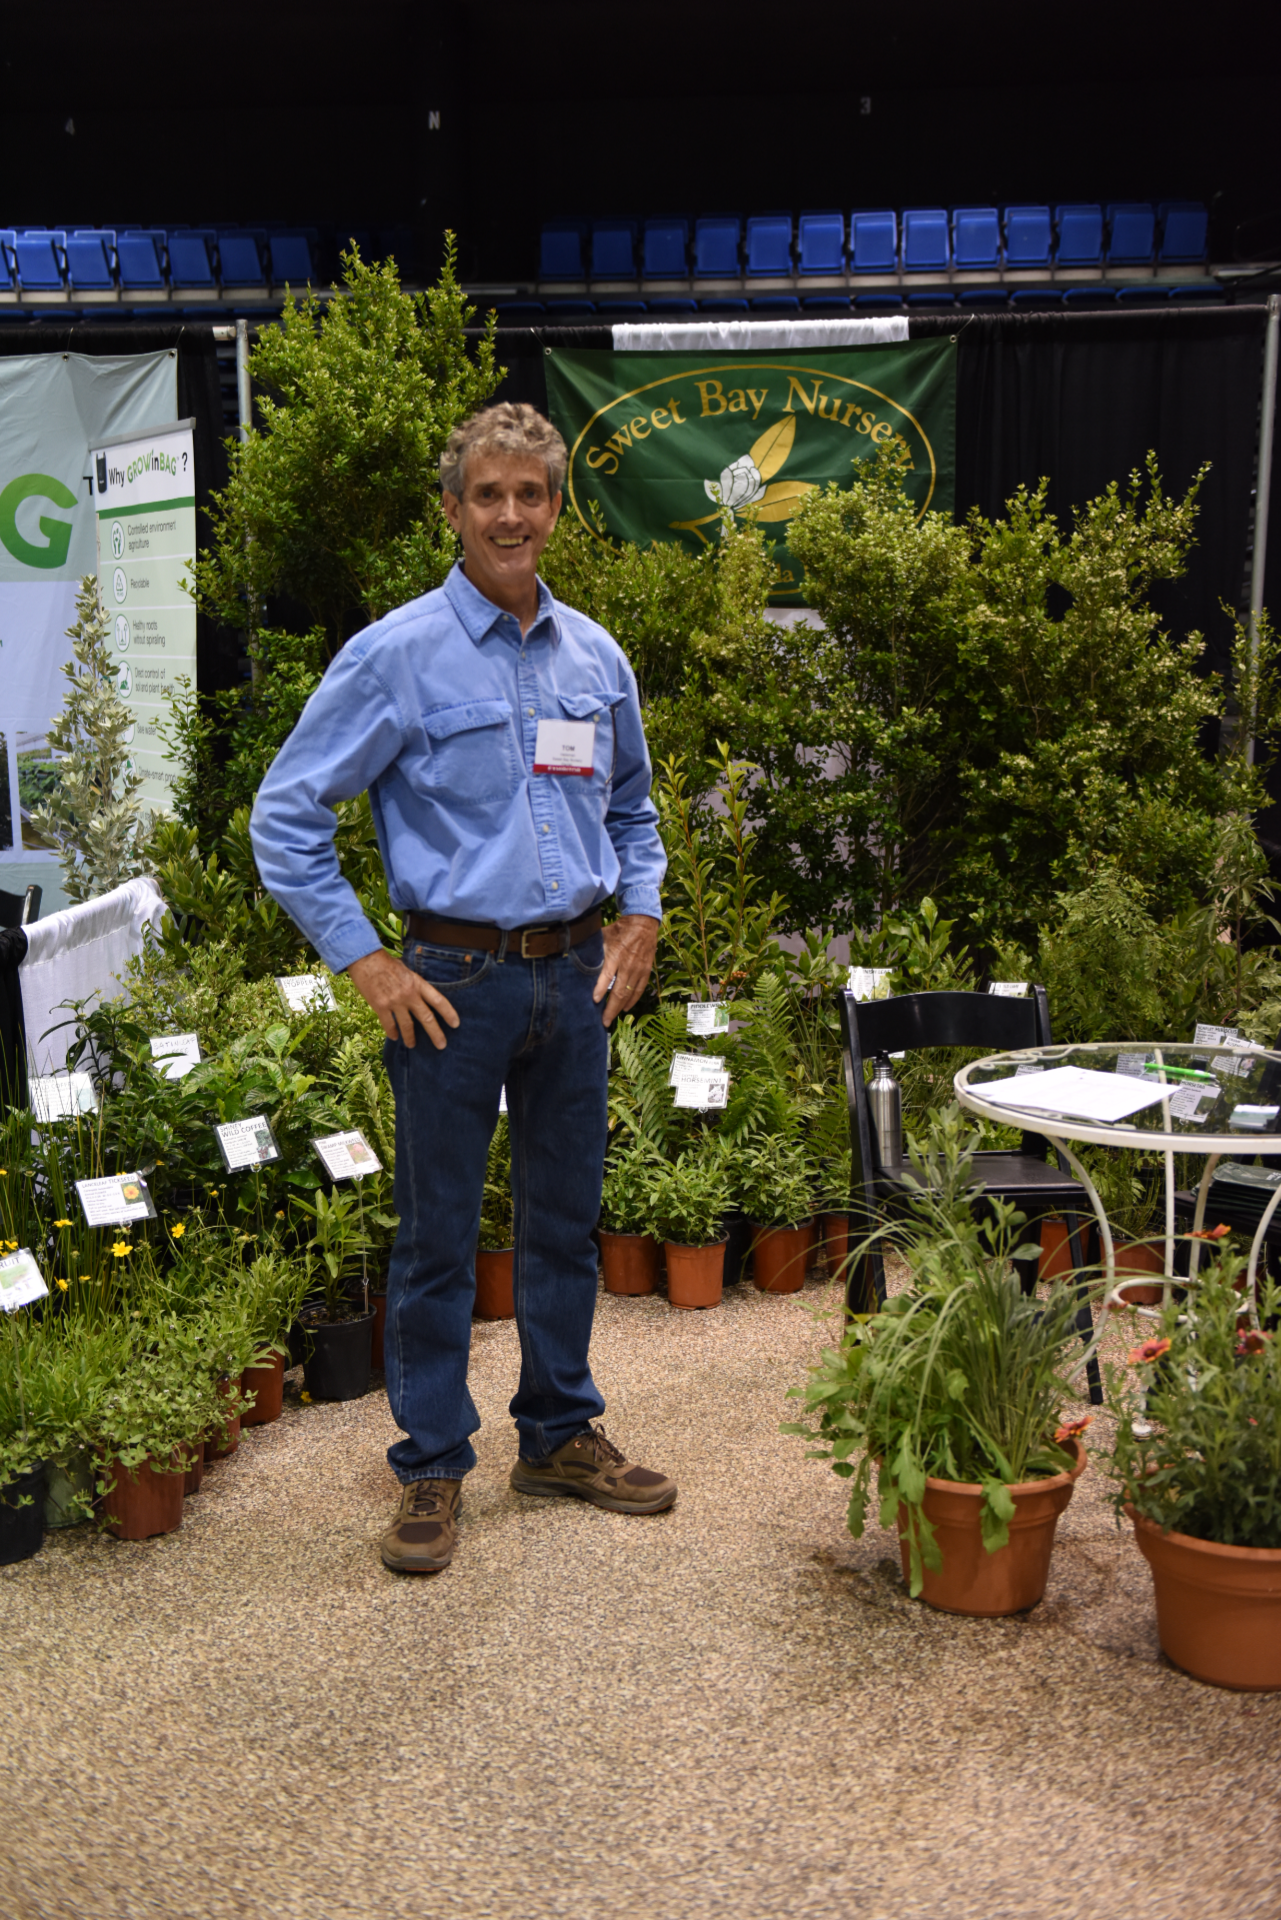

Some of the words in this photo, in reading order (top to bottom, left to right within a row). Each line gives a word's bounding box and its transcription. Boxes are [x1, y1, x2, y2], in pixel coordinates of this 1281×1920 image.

[860, 97, 871, 115] 3
[428, 110, 440, 129] N
[585, 397, 687, 475] Sweet
[694, 379, 769, 421] Bay
[108, 467, 125, 488] Why
[126, 448, 177, 484] GROWinBAG
[181, 451, 188, 473] ?
[127, 522, 149, 537] Controlled
[149, 519, 177, 535] environment
[128, 538, 150, 553] agriculture
[146, 620, 158, 631] roots
[146, 635, 166, 648] spiraling
[144, 668, 160, 679] control
[160, 668, 166, 679] of
[149, 683, 160, 694] plant
[561, 744, 575, 752] TOM
[283, 979, 314, 989] STOPPER
[676, 1055, 708, 1065] CINNAMON
[220, 1122, 242, 1133] SHINEY
[221, 1129, 240, 1138] WILD
[241, 1122, 267, 1133] COFFEE
[82, 1180, 108, 1188] LANCELEAF
[108, 1175, 136, 1184] TICKSEED
